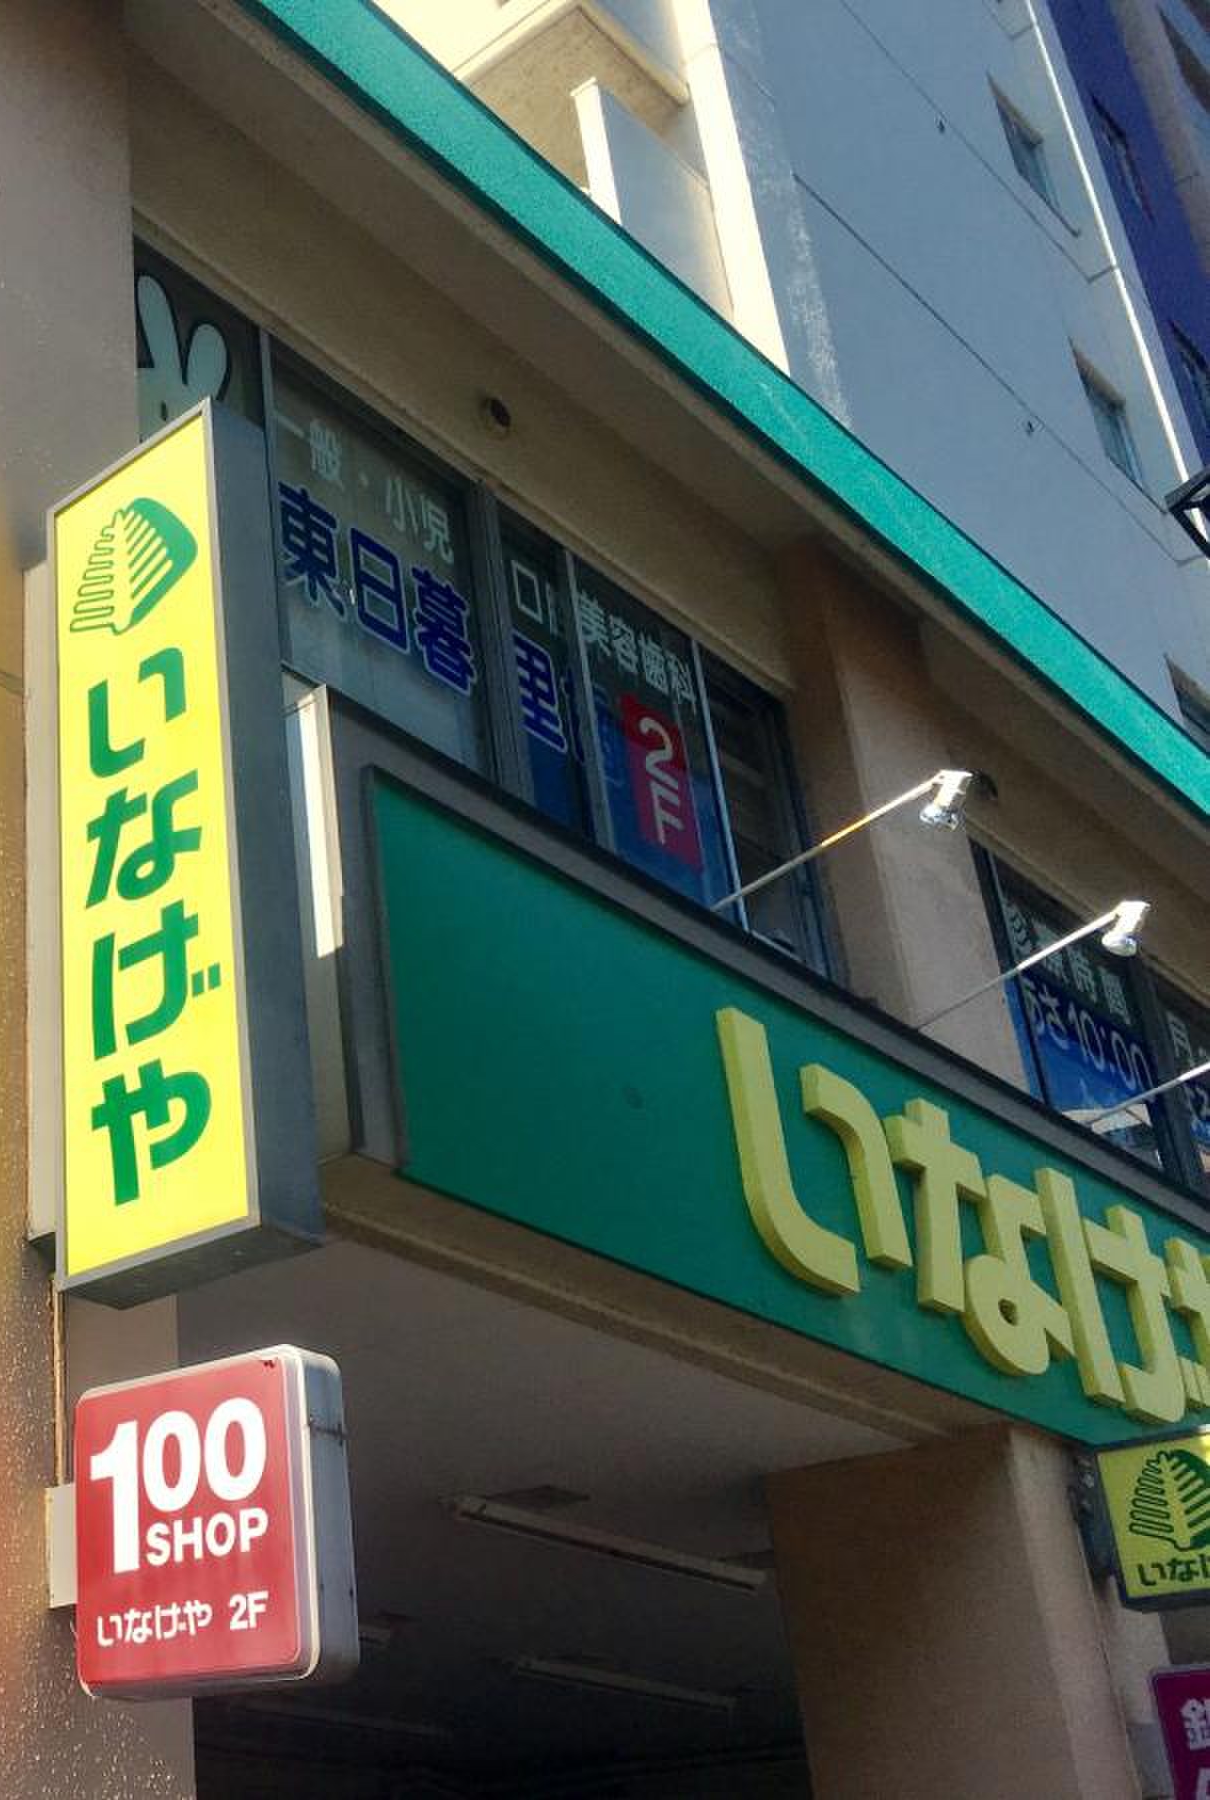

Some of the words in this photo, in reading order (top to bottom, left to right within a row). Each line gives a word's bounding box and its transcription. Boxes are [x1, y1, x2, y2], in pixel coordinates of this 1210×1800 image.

[638, 716, 684, 845] 2F
[85, 646, 222, 1207] いなげや
[90, 1397, 267, 1574] 100
[146, 1507, 269, 1567] SHOP
[1136, 1553, 1210, 1587] いな
[97, 1599, 212, 1647] いなげや
[229, 1590, 269, 1631] 2F
